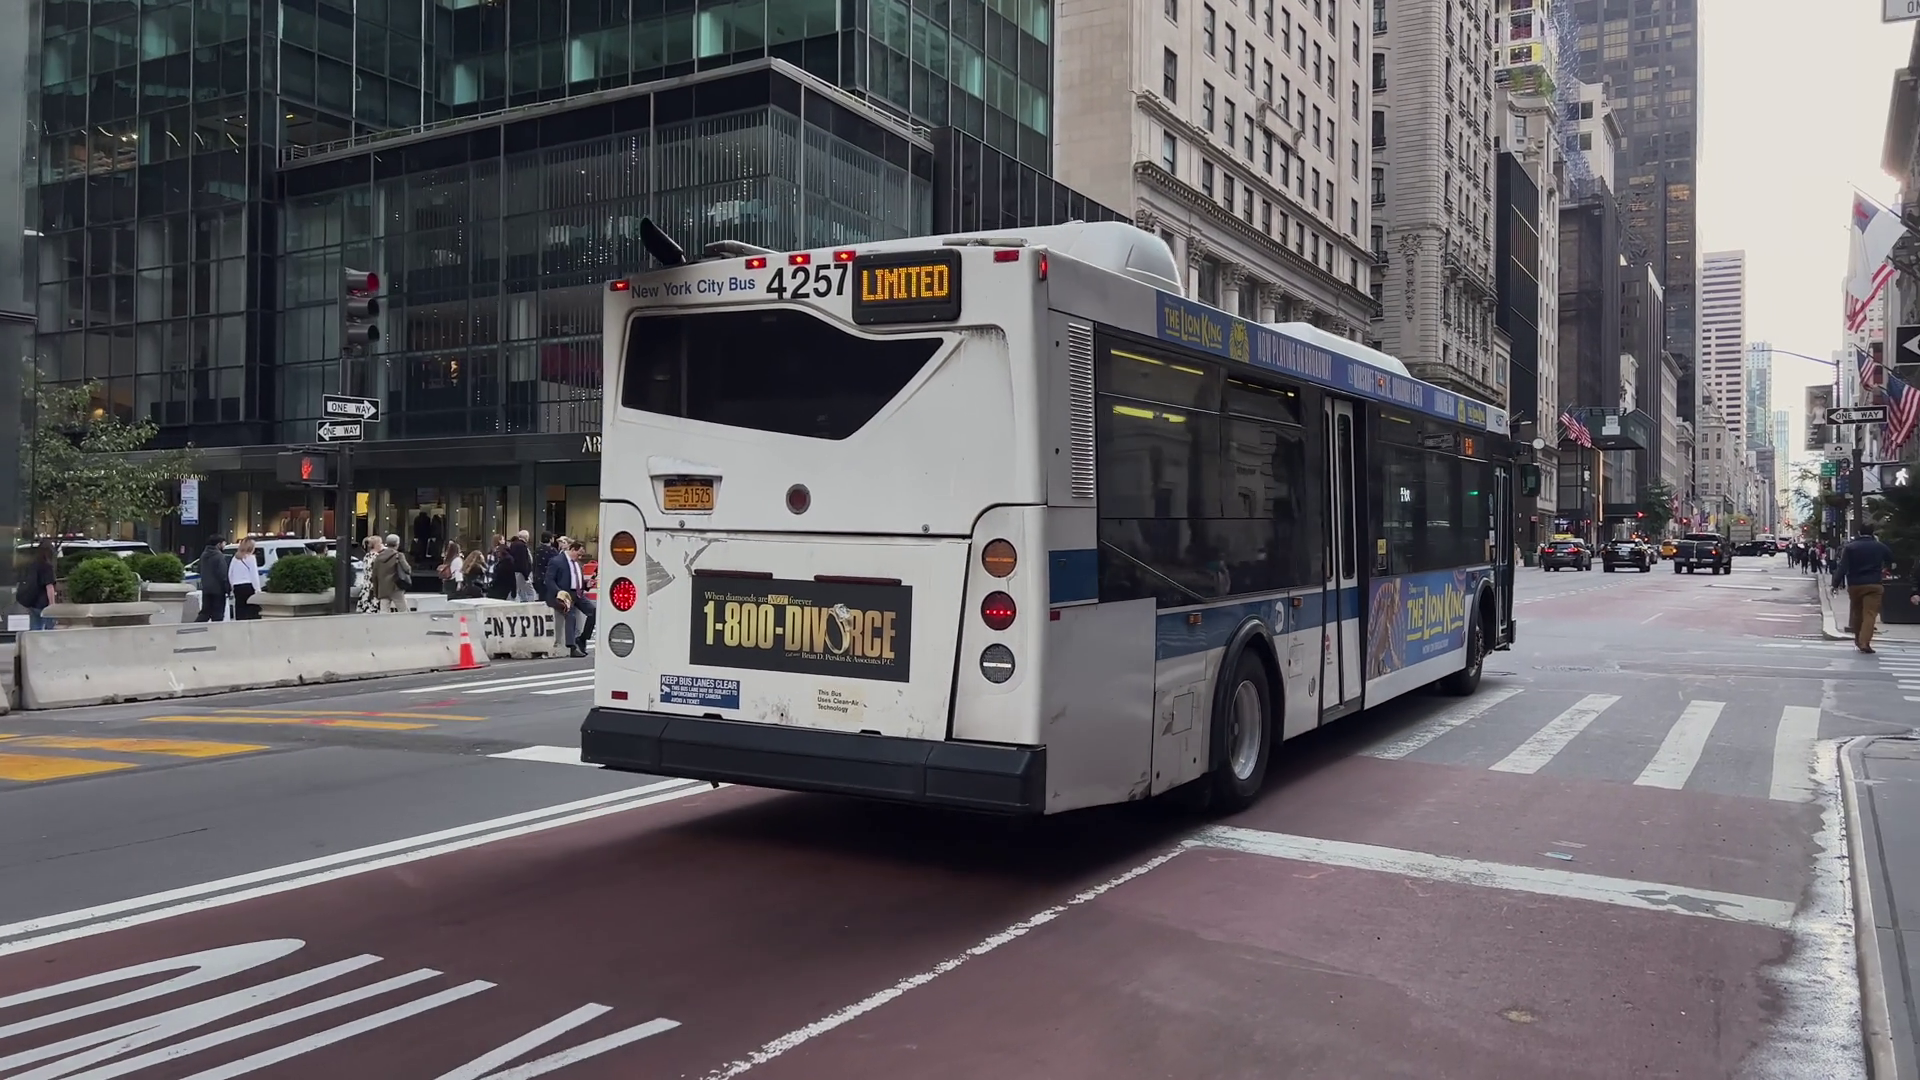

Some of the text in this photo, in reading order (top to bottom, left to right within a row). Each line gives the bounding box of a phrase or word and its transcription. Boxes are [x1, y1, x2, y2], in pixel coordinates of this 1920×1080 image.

[631, 277, 755, 299] New York City Bus
[766, 263, 848, 300] 4257
[862, 264, 948, 301] LIMITED
[1164, 306, 1222, 348] THE LION KING
[331, 402, 371, 414] ONE WAY
[1835, 411, 1880, 420] ONE WAY
[323, 425, 358, 436] ONE WAY
[704, 591, 813, 606] When diamonds are NOT forever
[1407, 583, 1464, 640] THE LION KING
[493, 615, 544, 638] NYPD
[801, 651, 816, 660] Brian
[825, 654, 845, 663] Perskin
[845, 655, 852, 663] &
[852, 656, 881, 665] Associates
[661, 675, 737, 690] KEEP BUS LANES CLEAR
[817, 696, 859, 706] Uses Clean-Air
[817, 703, 848, 713] Technology
